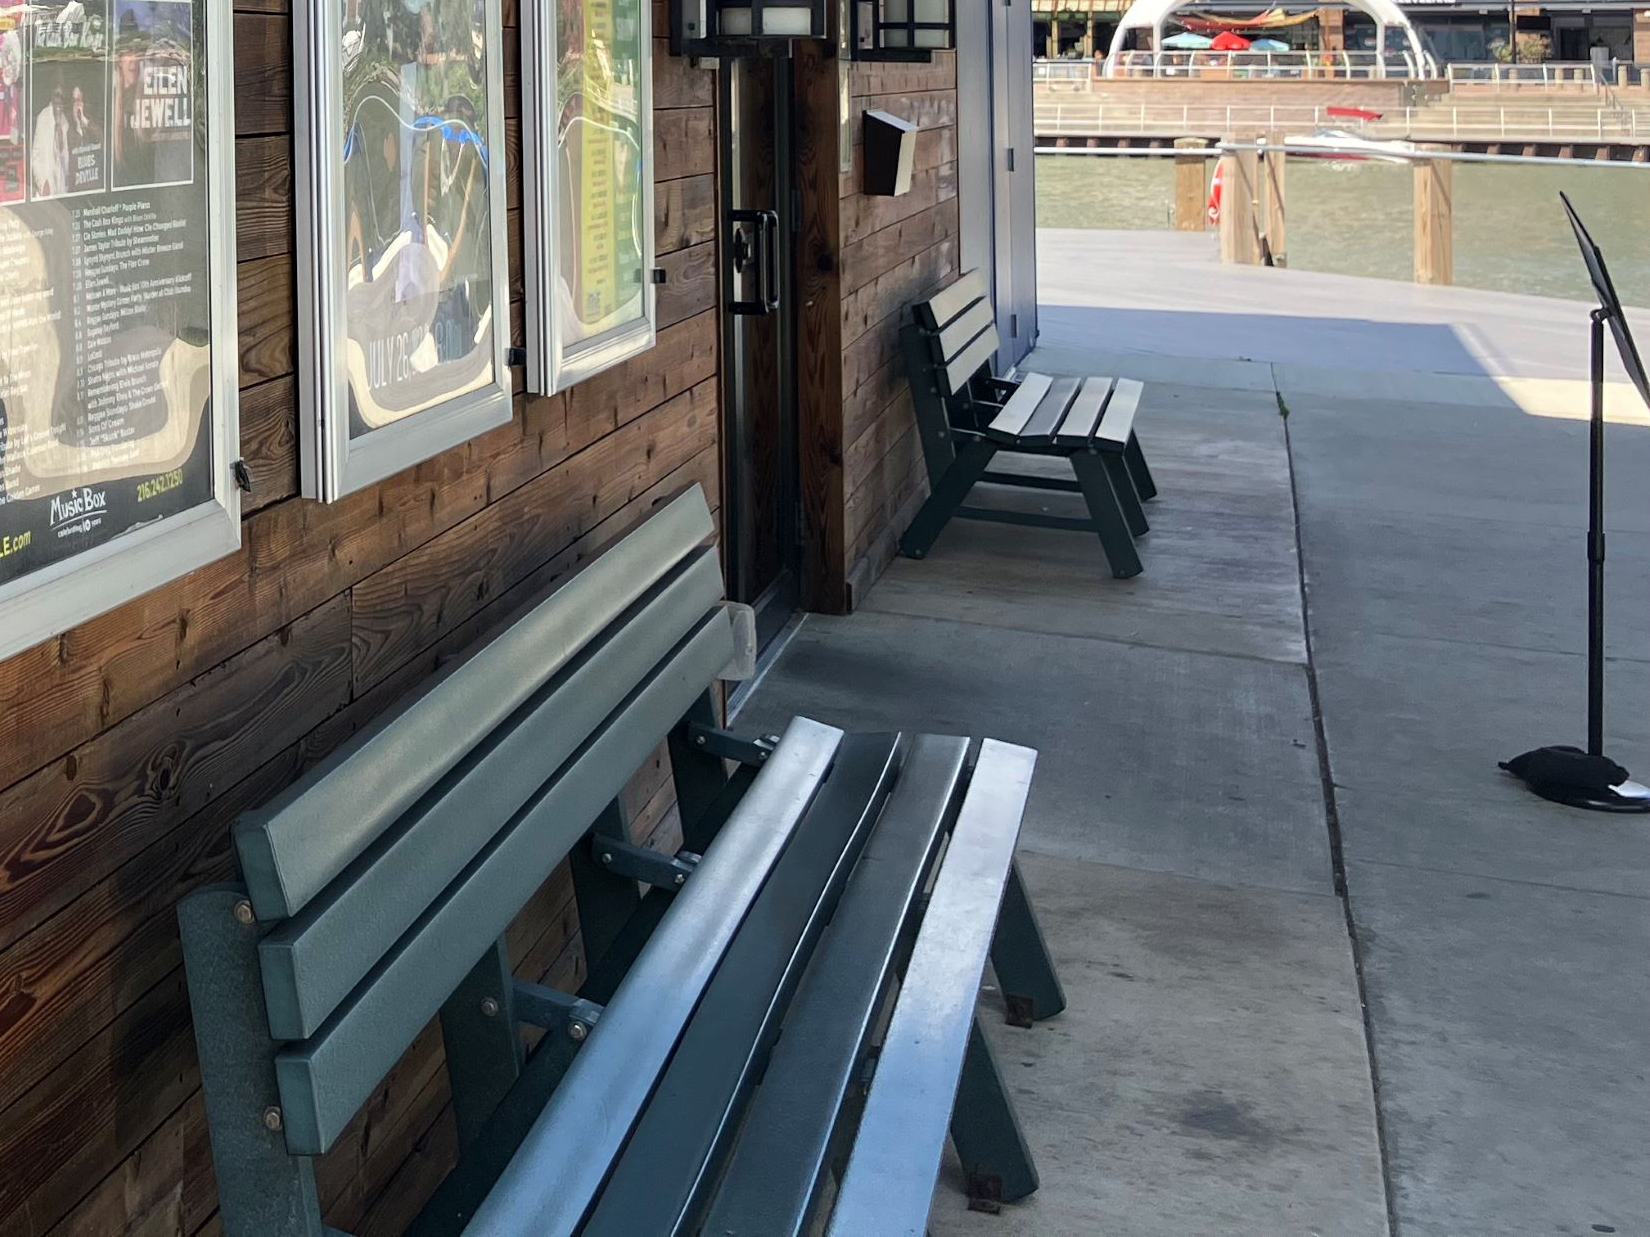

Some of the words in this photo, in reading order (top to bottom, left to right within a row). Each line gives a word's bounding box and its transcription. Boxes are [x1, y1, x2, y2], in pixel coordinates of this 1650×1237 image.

[143, 65, 188, 95] EILEN
[130, 98, 191, 129] JEWELL
[136, 469, 183, 503] 216.242.1250
[50, 489, 83, 526] Music
[84, 488, 106, 509] Box
